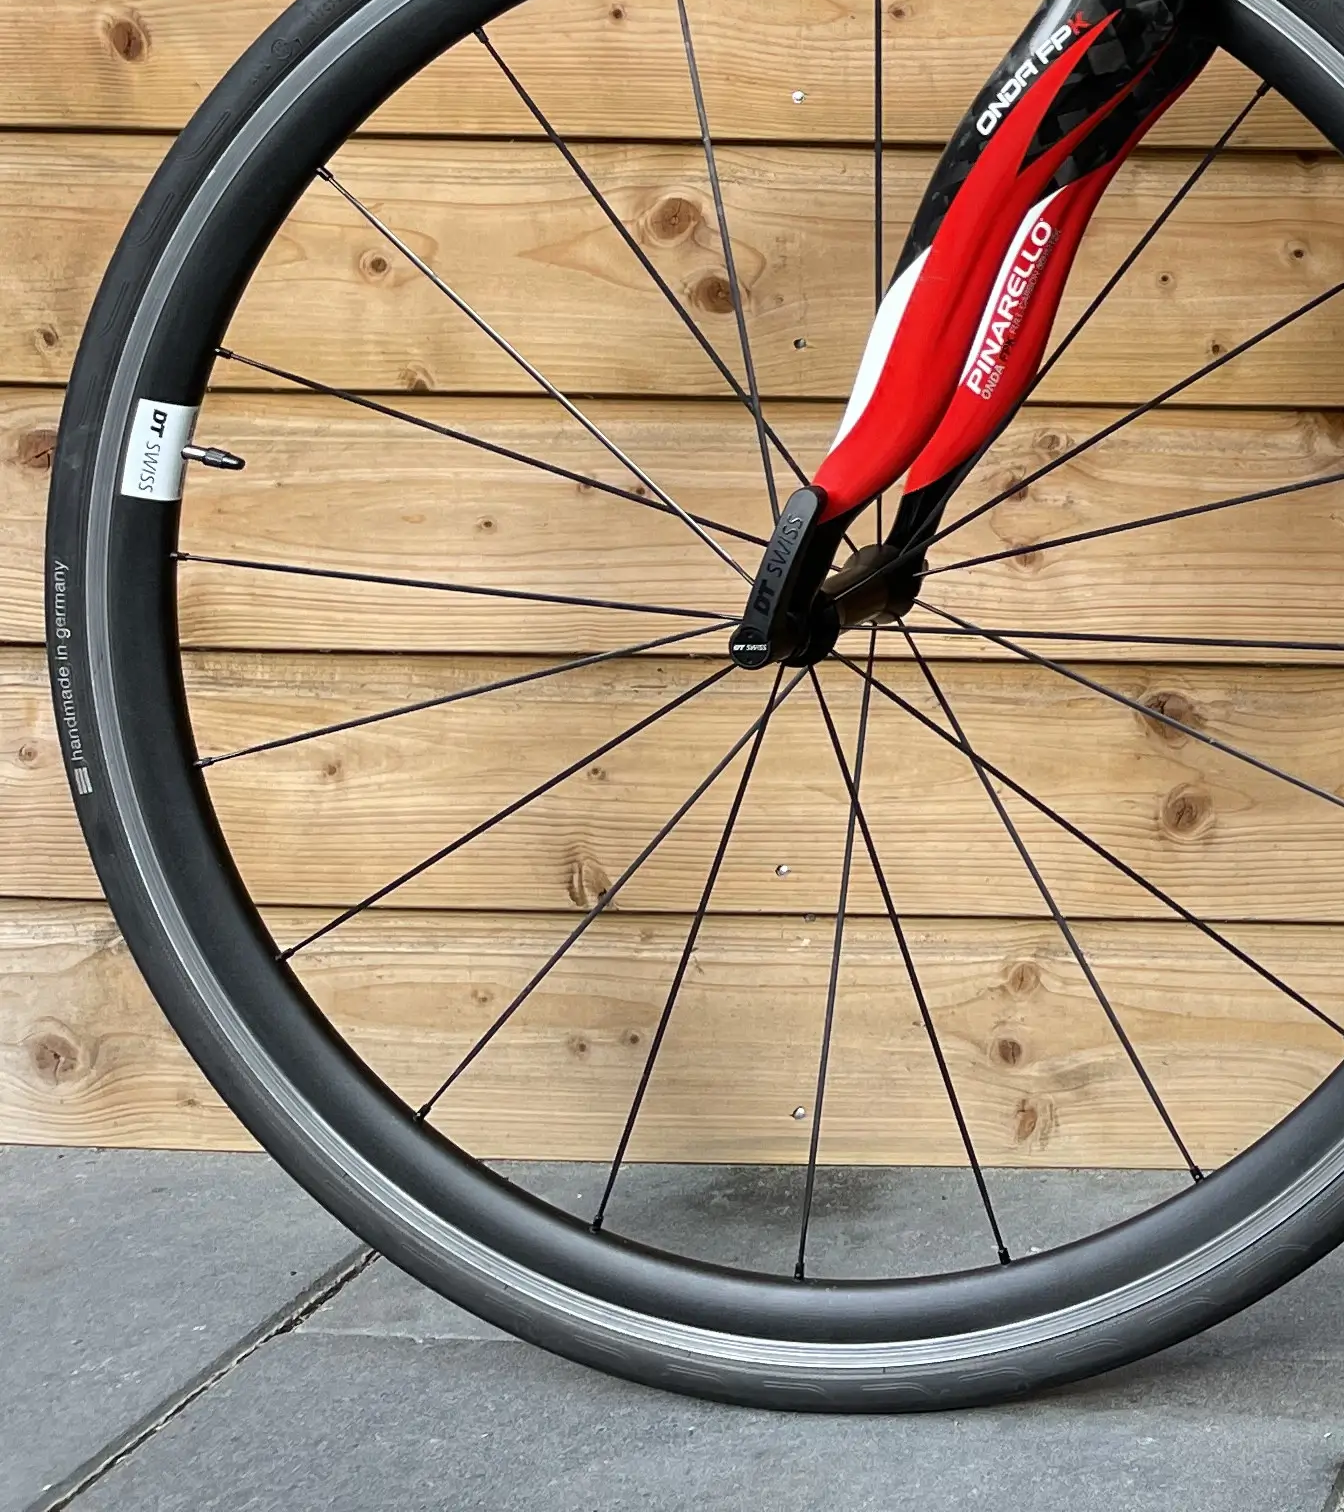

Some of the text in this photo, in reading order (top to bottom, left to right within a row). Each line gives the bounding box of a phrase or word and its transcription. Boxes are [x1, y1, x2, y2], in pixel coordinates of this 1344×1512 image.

[975, 10, 1091, 138] ONDA FPK
[967, 220, 1053, 396] PINARELLO
[981, 365, 1005, 401] ONDA
[137, 409, 168, 493] DT SWISS
[753, 513, 804, 616] DT SWISS
[54, 560, 84, 763] handmade in germany
